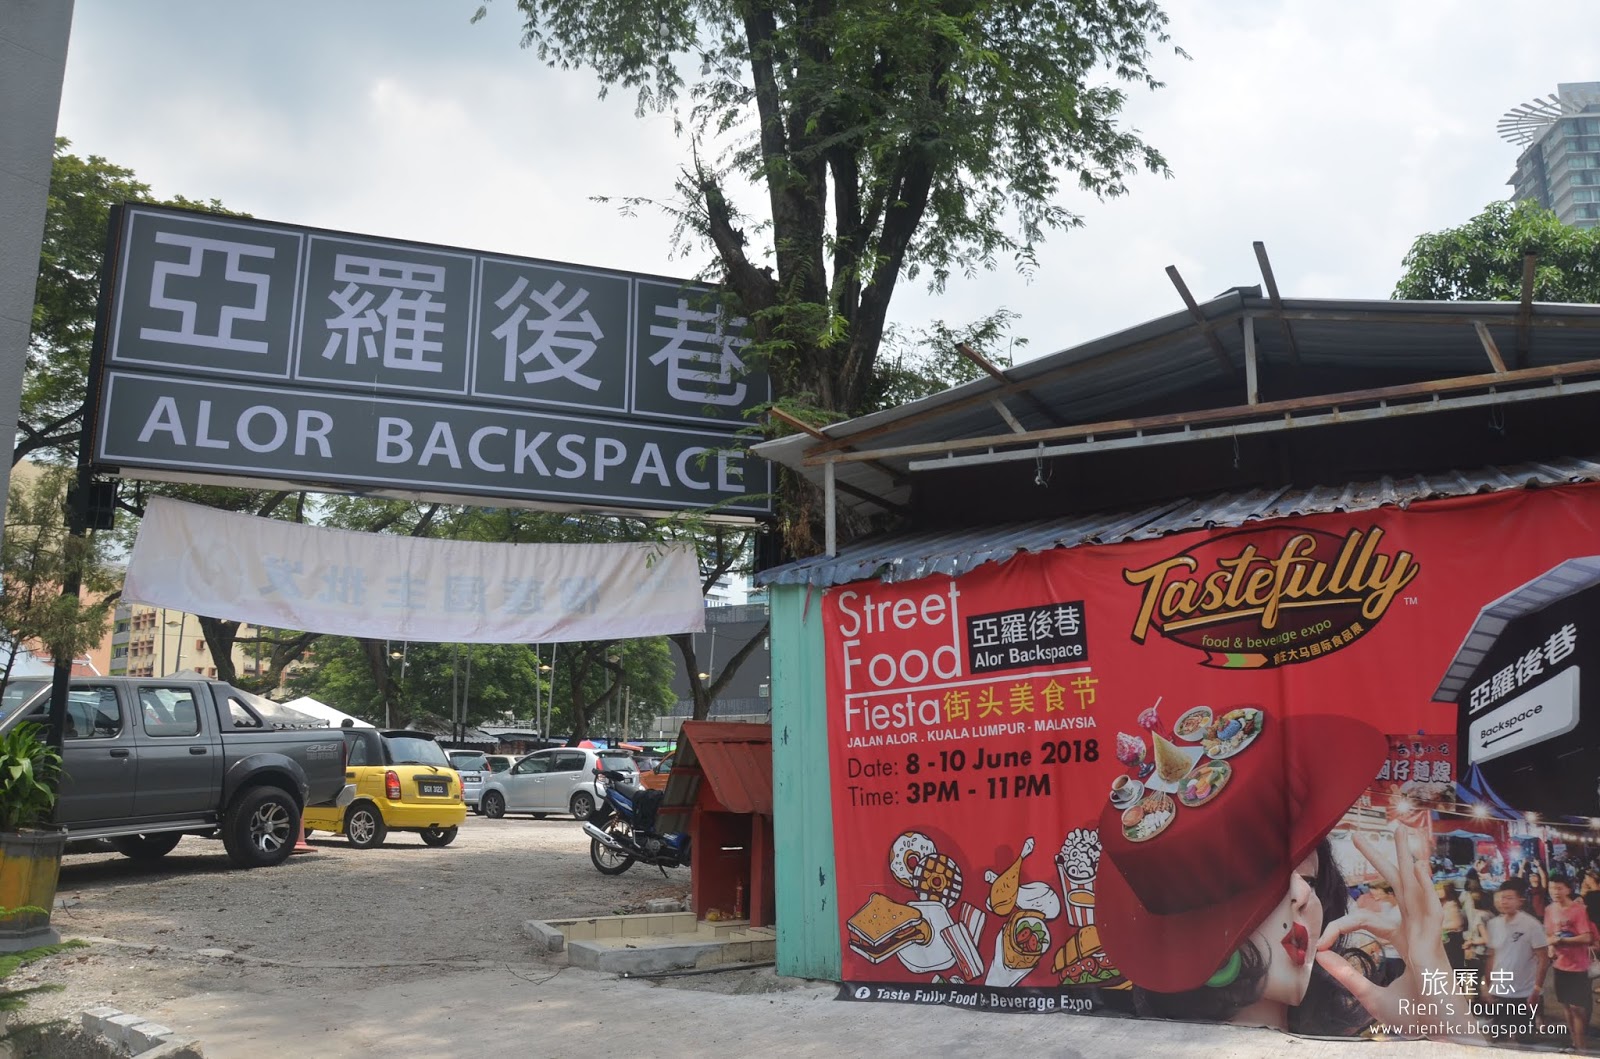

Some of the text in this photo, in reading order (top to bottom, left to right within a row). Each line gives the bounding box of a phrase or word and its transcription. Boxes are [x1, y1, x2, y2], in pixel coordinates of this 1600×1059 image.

[139, 230, 753, 407] 亞羅後巷
[137, 395, 746, 493] ALOR BACKSPACE
[1125, 525, 1420, 643] Tastefully
[838, 581, 961, 638] Street
[972, 605, 1081, 648] 亞羅後巷
[1202, 634, 1230, 648] food
[1233, 637, 1243, 649] &
[1300, 618, 1332, 638] expo
[843, 639, 963, 690] Food
[974, 644, 1083, 668] Alor Backspace
[1468, 623, 1577, 715] 亞羅後巷
[845, 694, 941, 732] Fiesta
[943, 676, 1099, 722] 街头美食节
[847, 733, 884, 748] JALAN
[885, 731, 918, 746] ALOR
[927, 727, 969, 742] KUALA
[972, 722, 1026, 738] LUMPUR
[1034, 716, 1097, 732] MALAYSIA
[1480, 703, 1543, 740] Backspace
[848, 757, 898, 778] Date:
[906, 753, 921, 775] 8
[972, 747, 1033, 771] June
[1041, 738, 1100, 765] 2018
[848, 785, 900, 807] Time:
[906, 780, 960, 804] 3PM
[877, 988, 911, 1001] Taste
[914, 989, 947, 1003] Fully
[949, 990, 978, 1006] Food
[991, 995, 1055, 1011] Beverage
[1060, 995, 1093, 1012] Expo
